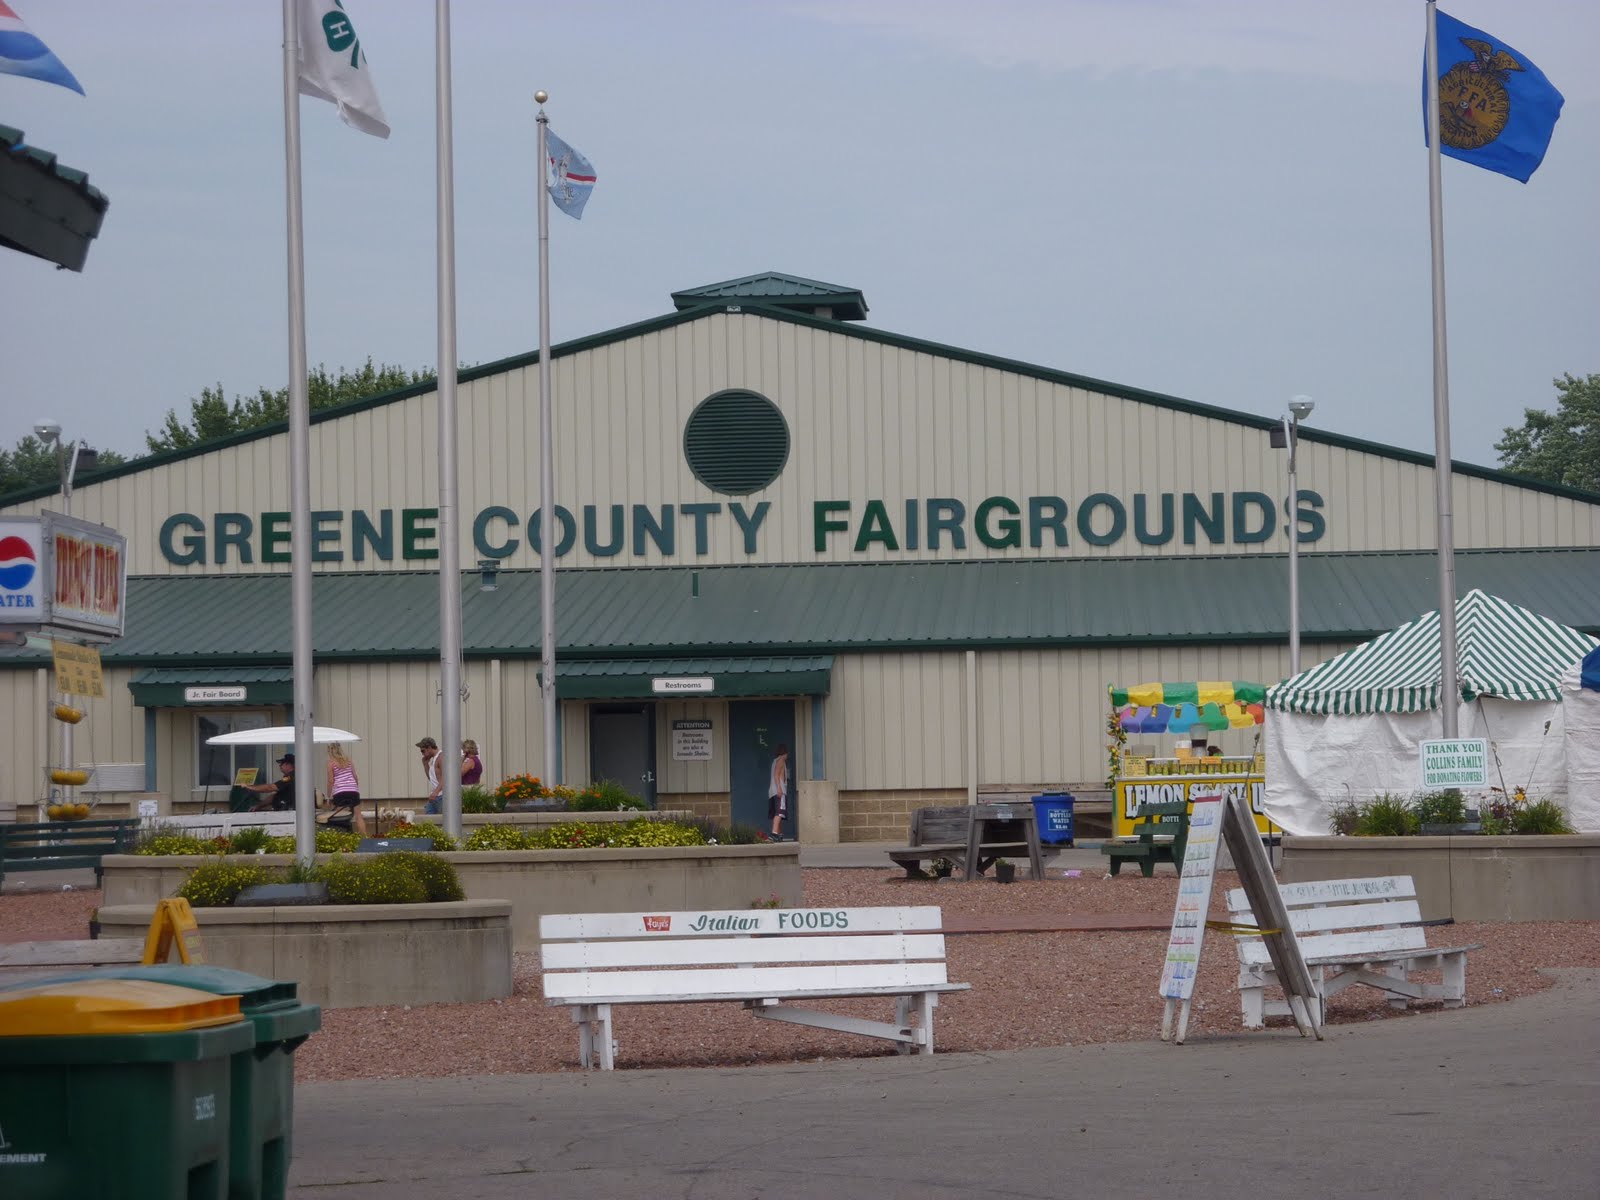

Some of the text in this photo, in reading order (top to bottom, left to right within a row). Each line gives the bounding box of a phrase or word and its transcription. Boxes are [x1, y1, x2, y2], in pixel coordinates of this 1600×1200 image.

[1458, 86, 1488, 112] FFA
[159, 489, 1326, 566] GREENE COUNTY FAIRGROUNDS
[1426, 743, 1482, 754] THANK YOU
[1426, 755, 1482, 770] COLLINS FAMILY
[1427, 771, 1482, 784] FOR DONATING FLOWERS
[689, 914, 760, 932] Italian
[778, 911, 849, 929] FOODS
